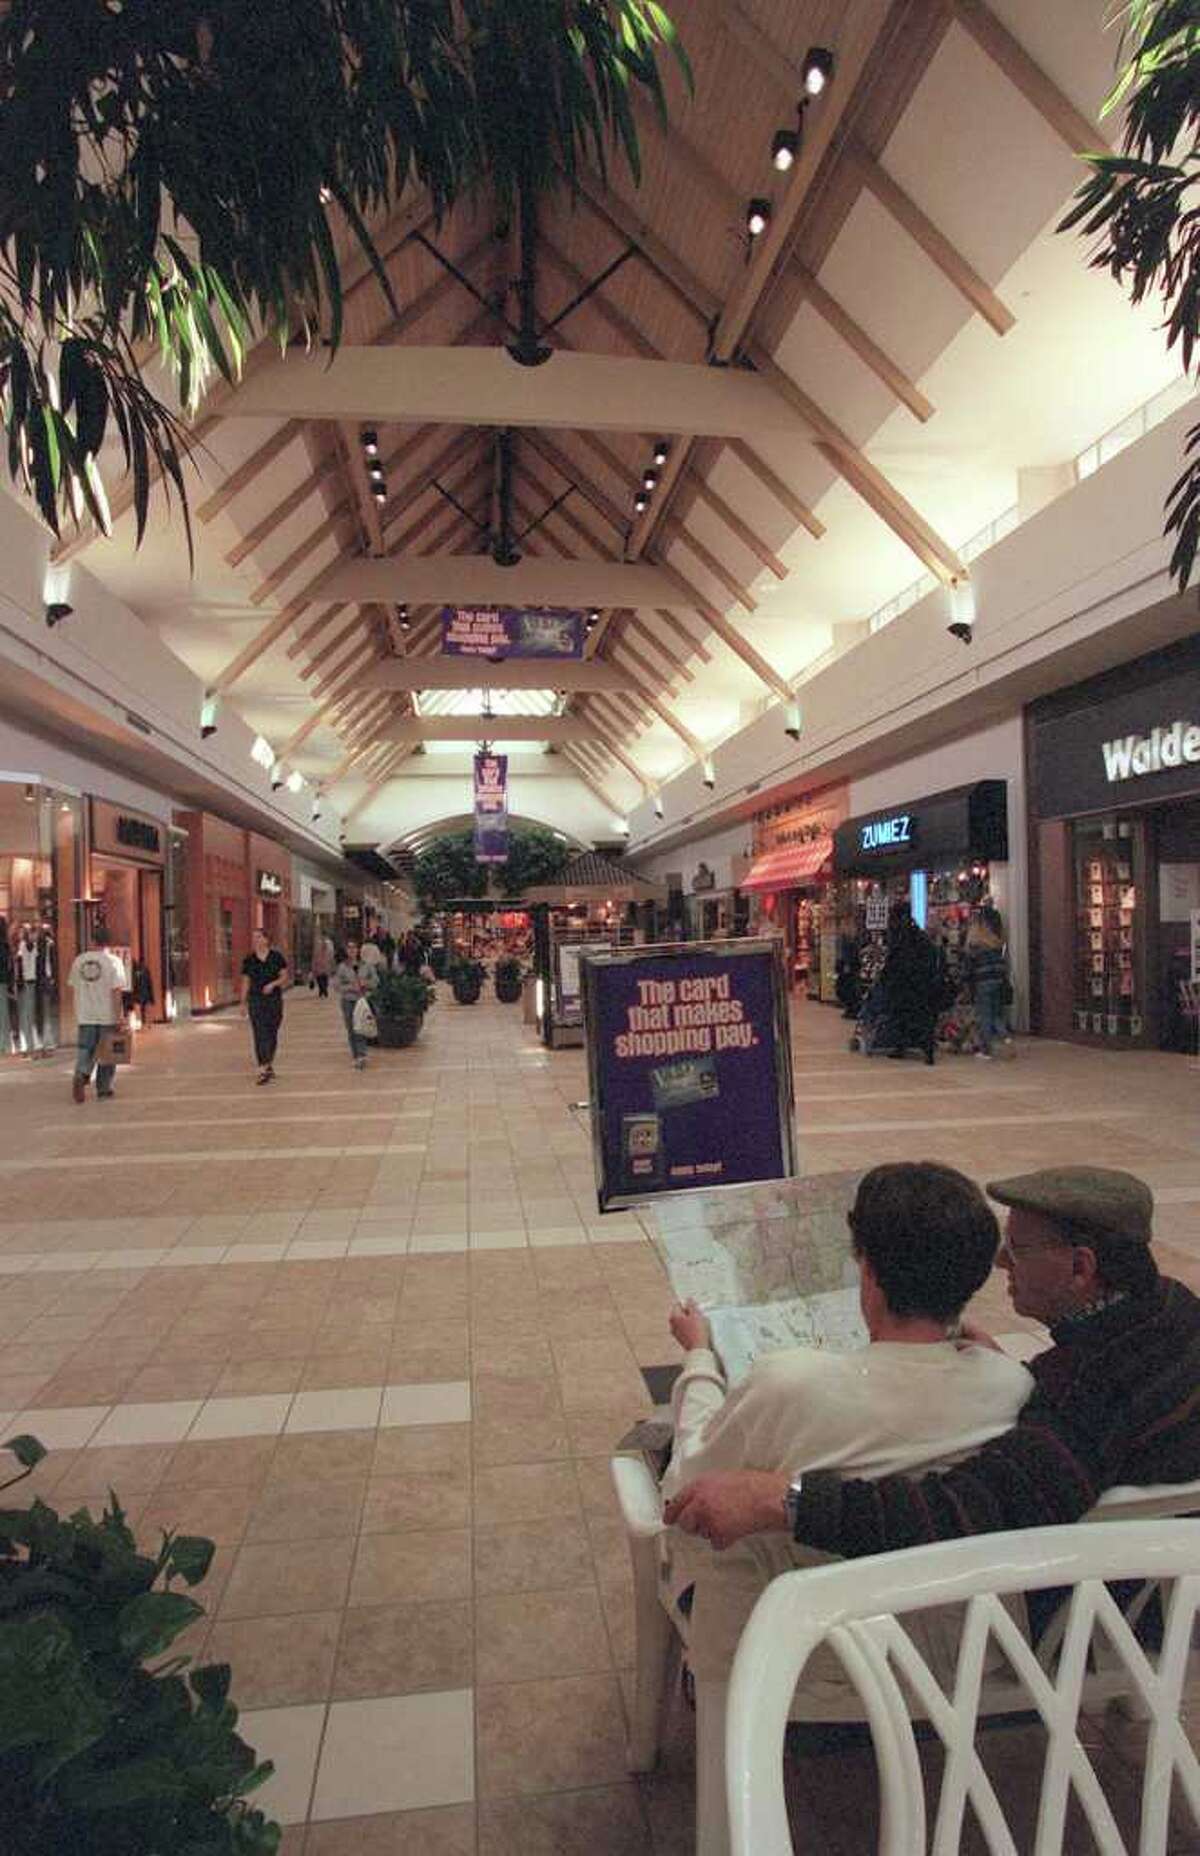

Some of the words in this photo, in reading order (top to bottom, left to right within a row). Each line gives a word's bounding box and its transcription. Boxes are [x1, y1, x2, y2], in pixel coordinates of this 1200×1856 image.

[1102, 722, 1200, 782] Walde
[862, 815, 910, 849] ZUMIEZ
[637, 979, 676, 1005] The
[679, 973, 729, 1002] card
[628, 1003, 671, 1031] that
[673, 999, 743, 1026] makes
[615, 1026, 711, 1057] shopping
[715, 1022, 760, 1051] pay.
